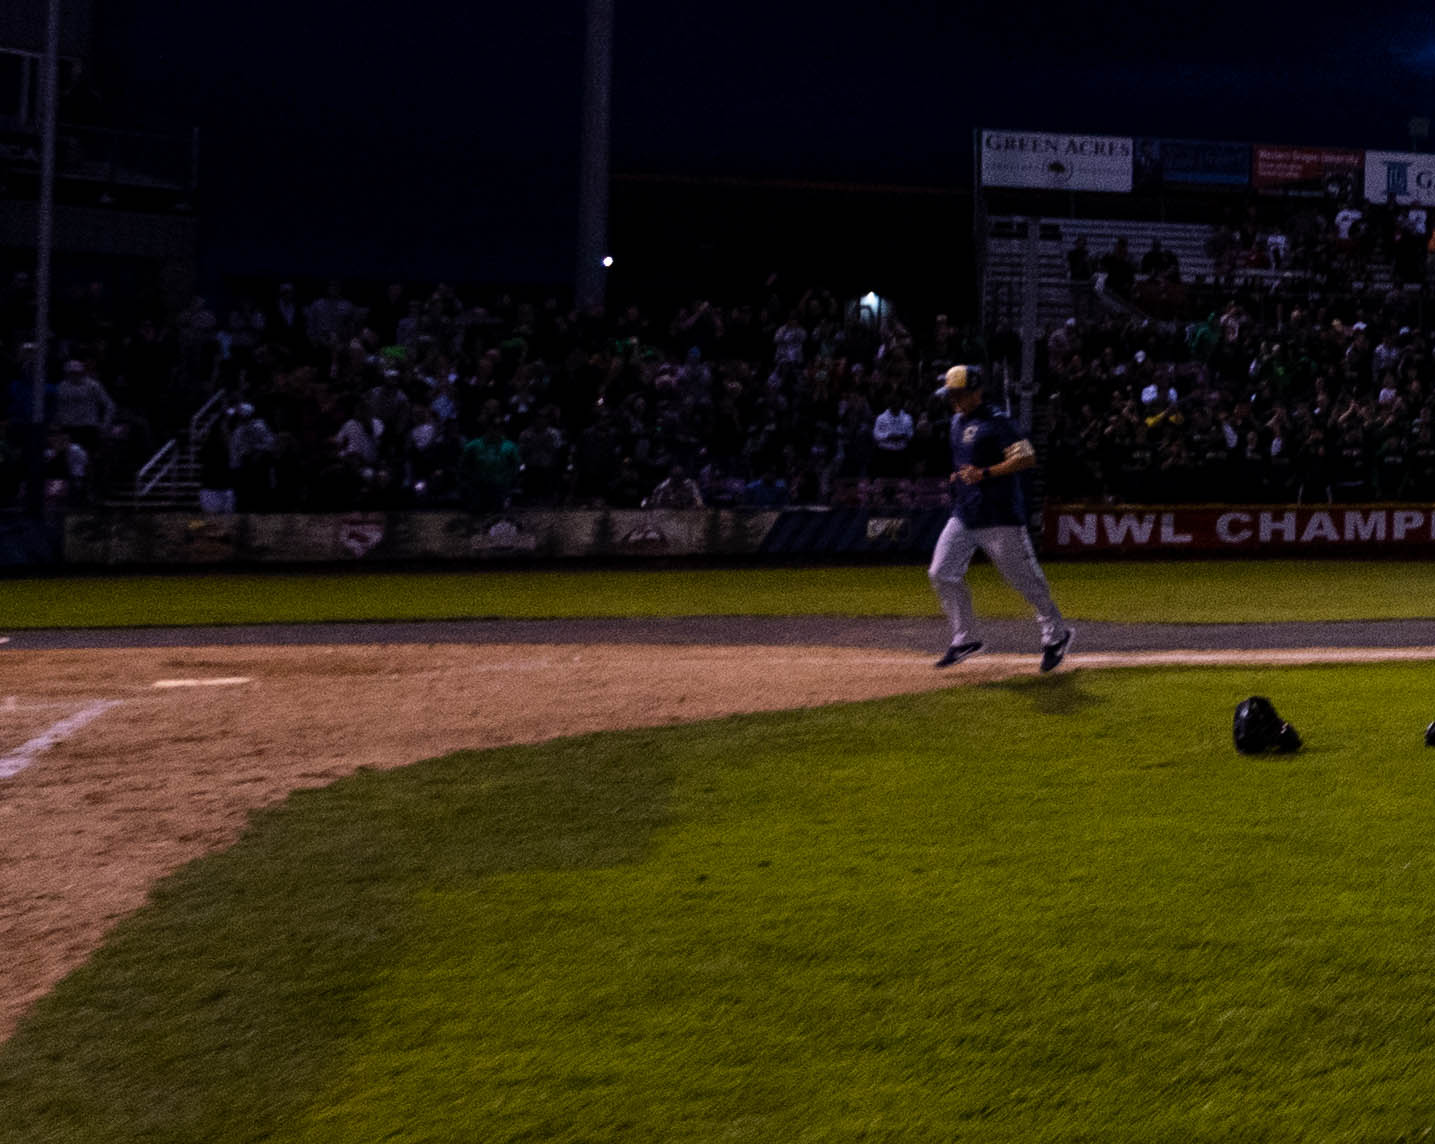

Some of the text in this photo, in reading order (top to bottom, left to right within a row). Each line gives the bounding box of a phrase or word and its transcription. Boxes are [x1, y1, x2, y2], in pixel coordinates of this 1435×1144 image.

[985, 134, 1131, 157] GREEN ACRES
[1057, 512, 1194, 546] NWL
